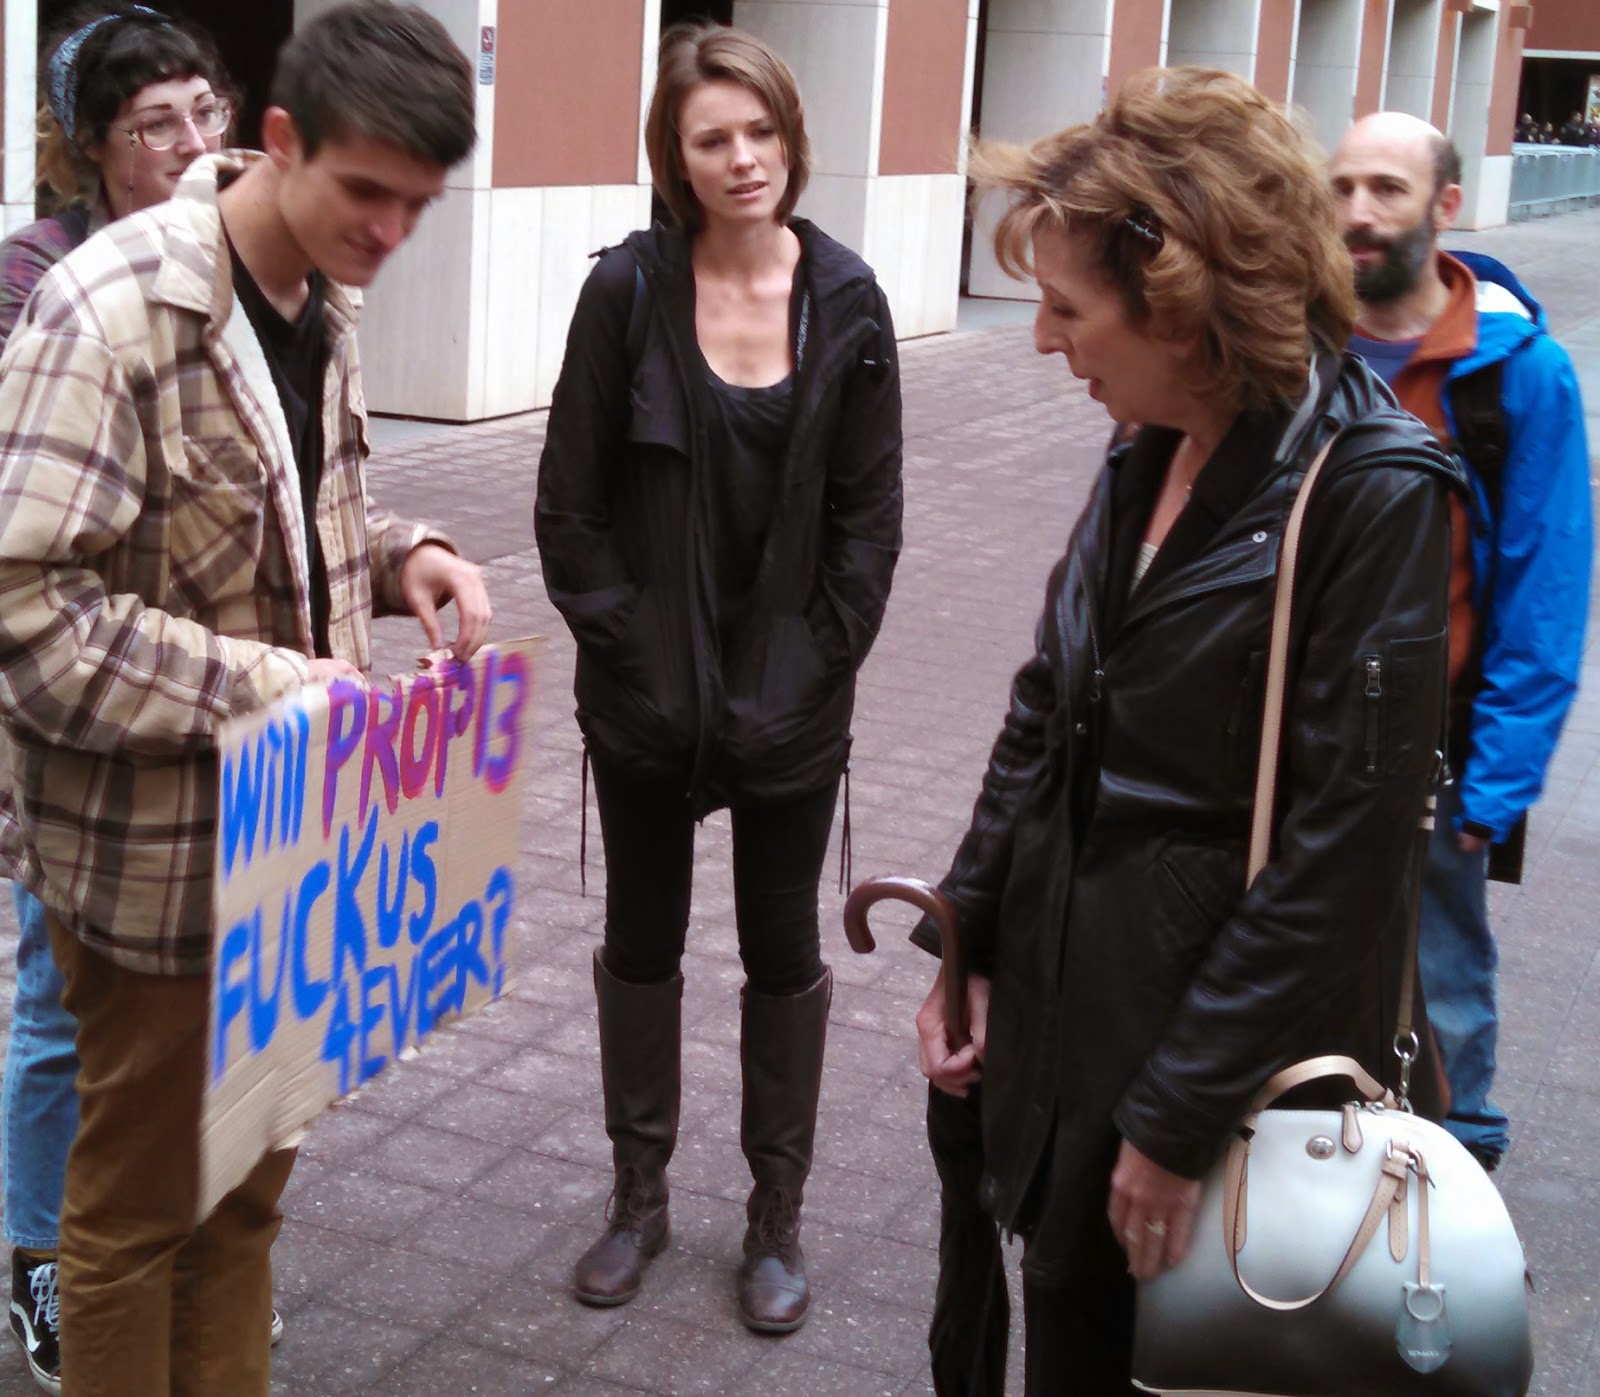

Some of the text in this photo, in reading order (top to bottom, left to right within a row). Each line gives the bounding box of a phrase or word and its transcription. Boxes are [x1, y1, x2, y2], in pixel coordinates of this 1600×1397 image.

[321, 656, 476, 843] PROP
[471, 649, 529, 794] 13
[211, 802, 440, 1088] FUCK US
[320, 865, 516, 1095] 4EVER?
